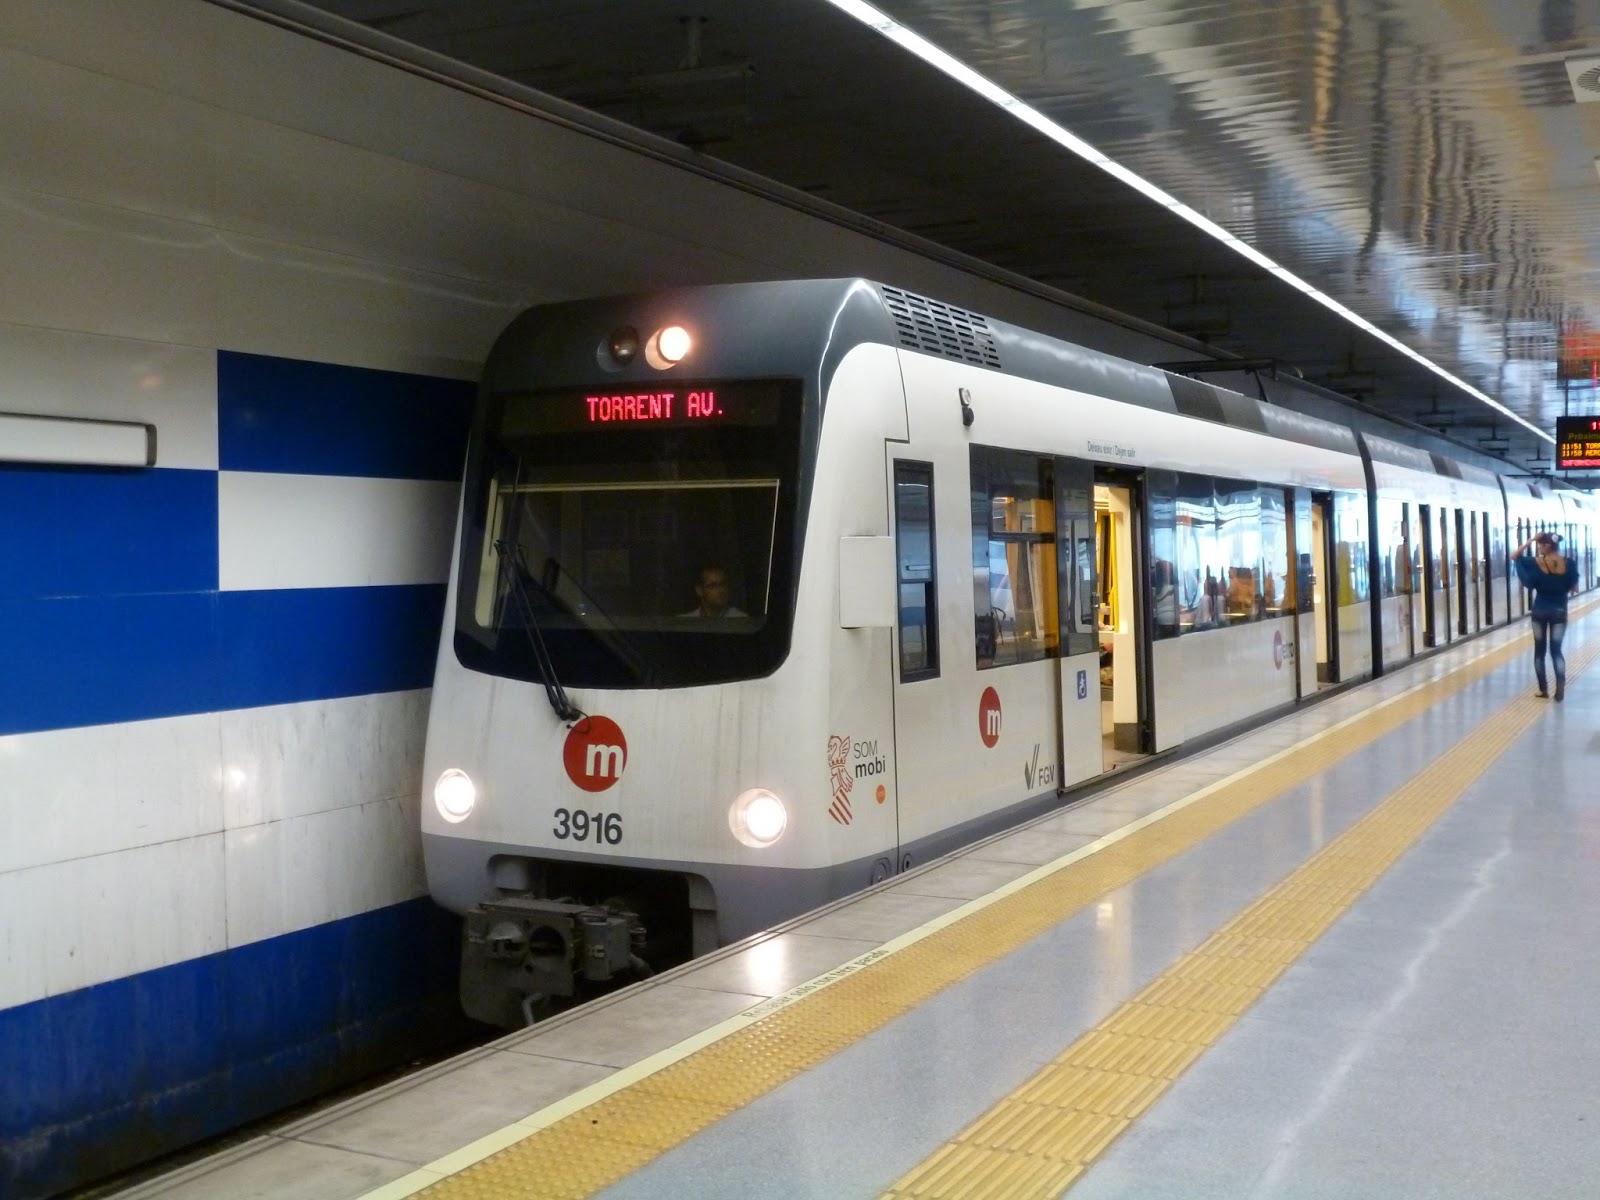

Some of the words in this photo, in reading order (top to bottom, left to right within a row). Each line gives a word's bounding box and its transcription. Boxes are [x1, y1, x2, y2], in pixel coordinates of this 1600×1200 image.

[586, 393, 675, 422] TORRENT
[687, 391, 723, 418] AV.
[987, 709, 1001, 736] m
[585, 743, 624, 779] m
[853, 740, 878, 759] SOM
[855, 754, 886, 779] mobi
[1038, 764, 1055, 787] FGV
[553, 807, 623, 845] 3916
